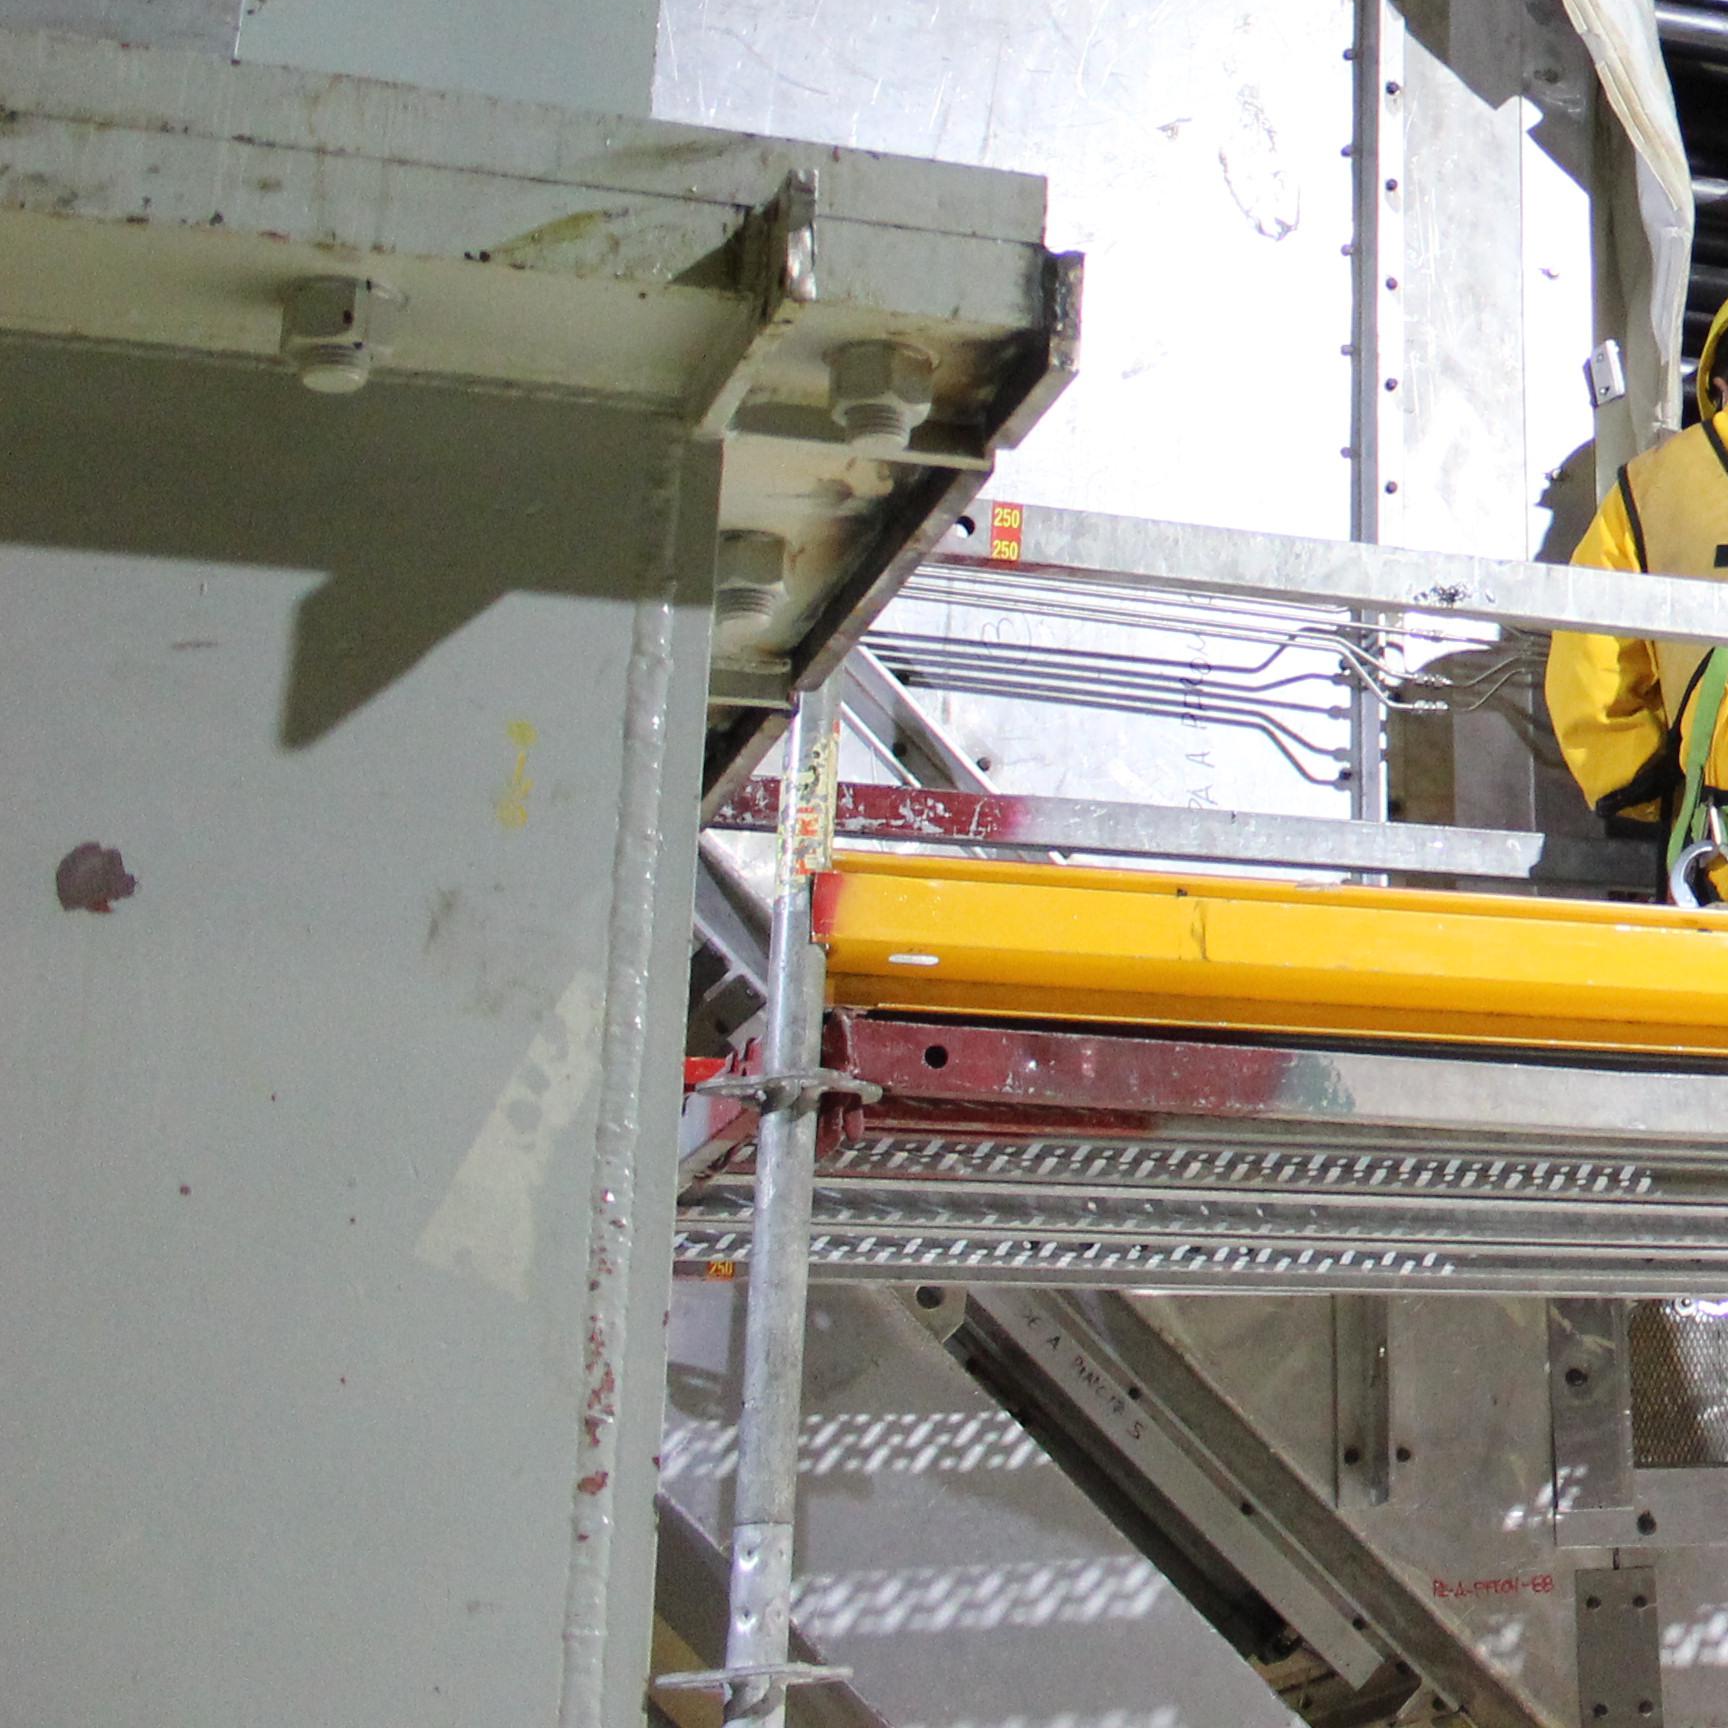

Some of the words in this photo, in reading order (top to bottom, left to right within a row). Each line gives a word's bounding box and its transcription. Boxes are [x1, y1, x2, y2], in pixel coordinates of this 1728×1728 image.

[994, 507, 1020, 529] 250
[992, 539, 1018, 561] 250
[708, 1259, 733, 1276] 250
